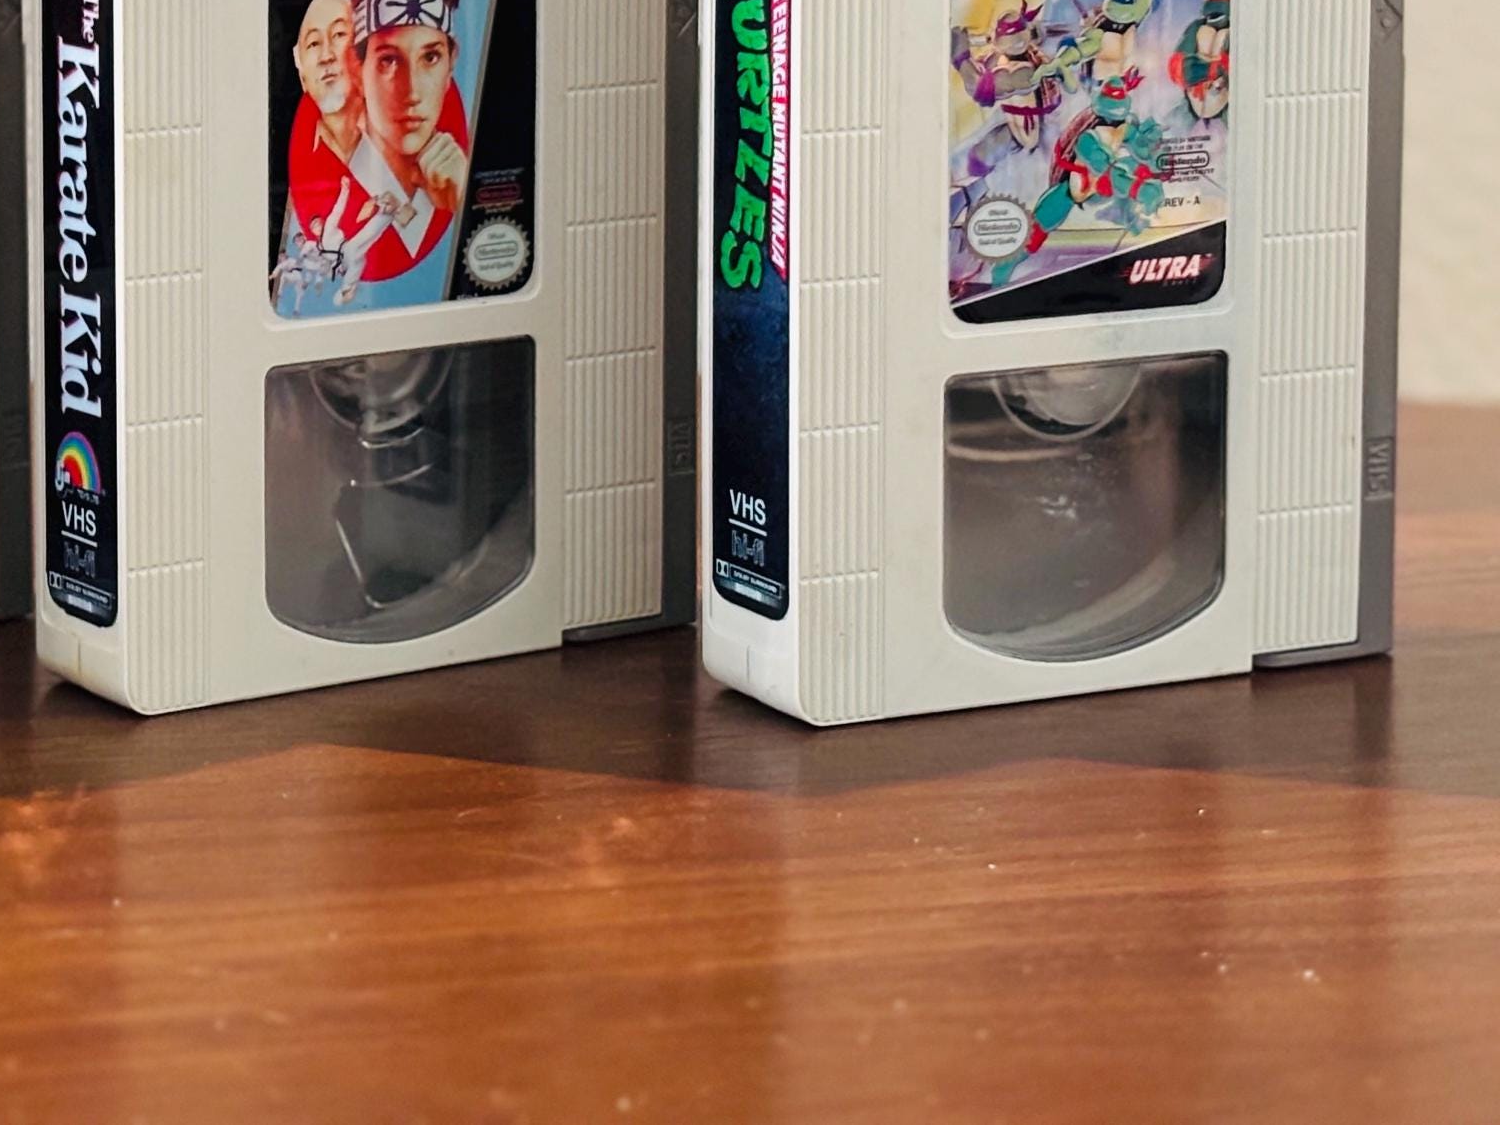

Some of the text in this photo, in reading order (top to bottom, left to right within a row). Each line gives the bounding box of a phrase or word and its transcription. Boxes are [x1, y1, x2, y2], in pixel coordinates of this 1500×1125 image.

[58, 35, 100, 283] Karate
[771, 100, 788, 192] MUTANT
[770, 191, 787, 269] NINJA
[1164, 196, 1184, 207] REV
[1129, 253, 1202, 284] ULTRA
[60, 284, 102, 418] Kid
[62, 500, 96, 537] VHS
[729, 488, 766, 526] VHS
